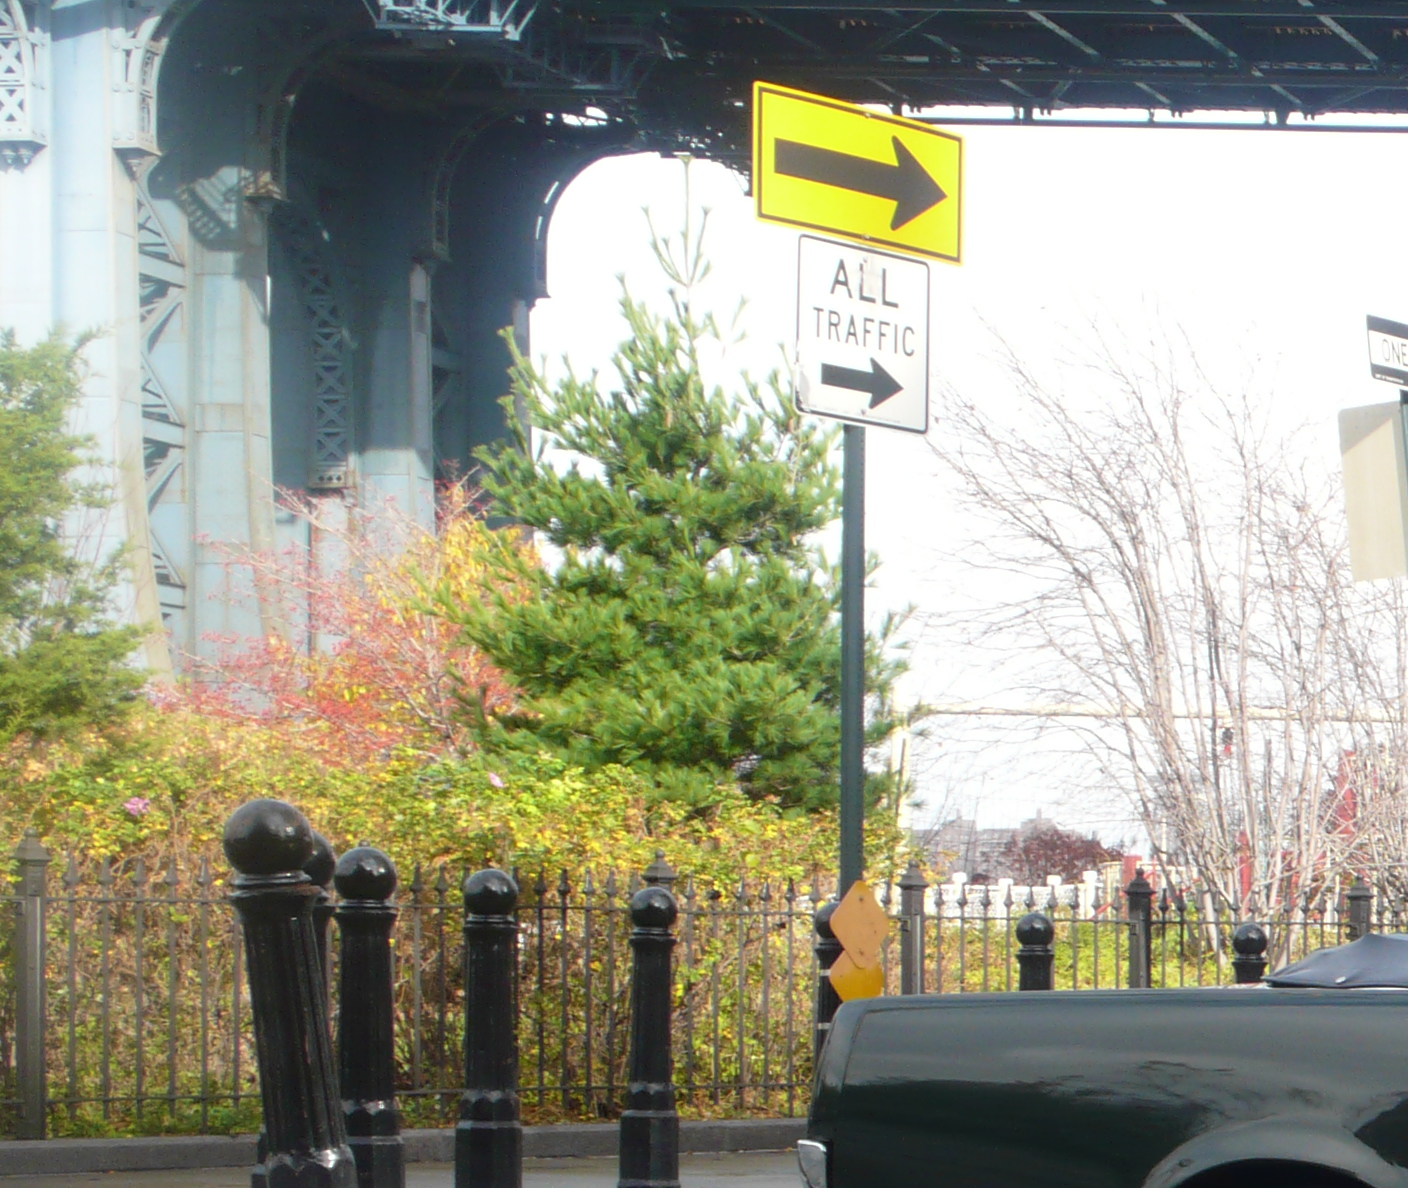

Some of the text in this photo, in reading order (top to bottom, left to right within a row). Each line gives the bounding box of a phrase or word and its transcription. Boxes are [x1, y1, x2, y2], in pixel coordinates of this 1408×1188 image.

[830, 259, 899, 308] ALL
[813, 307, 915, 357] TRAFFIC
[1382, 339, 1408, 367] ONE
